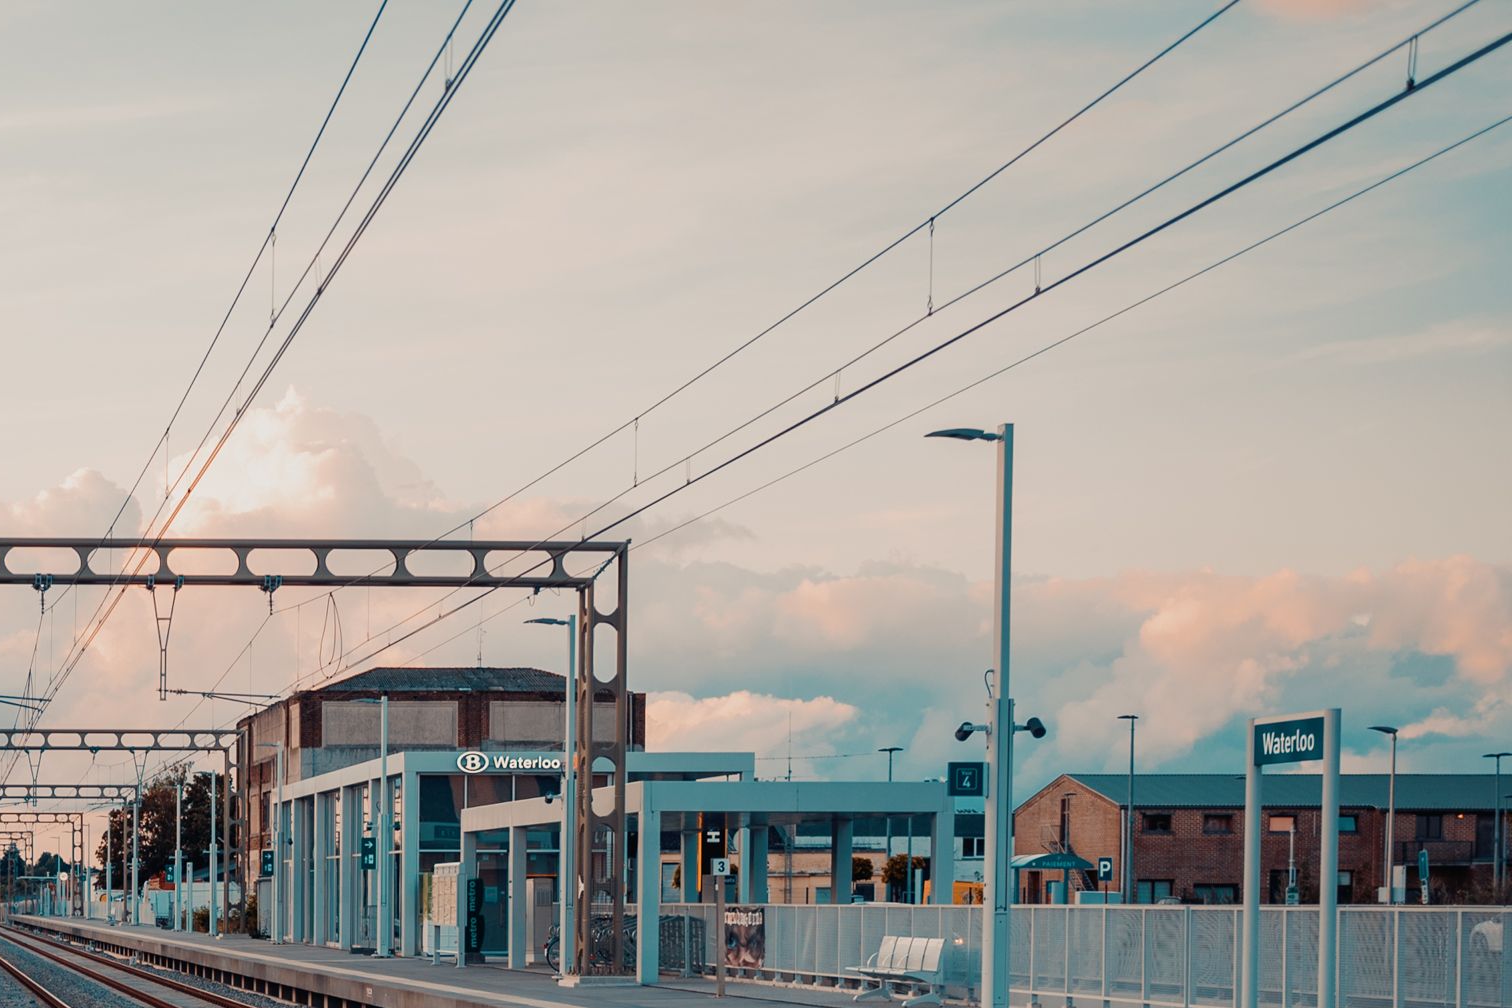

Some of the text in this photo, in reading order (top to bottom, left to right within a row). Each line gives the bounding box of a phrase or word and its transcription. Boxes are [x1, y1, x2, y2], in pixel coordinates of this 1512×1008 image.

[1262, 728, 1315, 755] Waterloo
[493, 756, 561, 769] Waterloo
[962, 776, 971, 787] 4
[718, 861, 725, 873] 3
[1099, 861, 1111, 878] P
